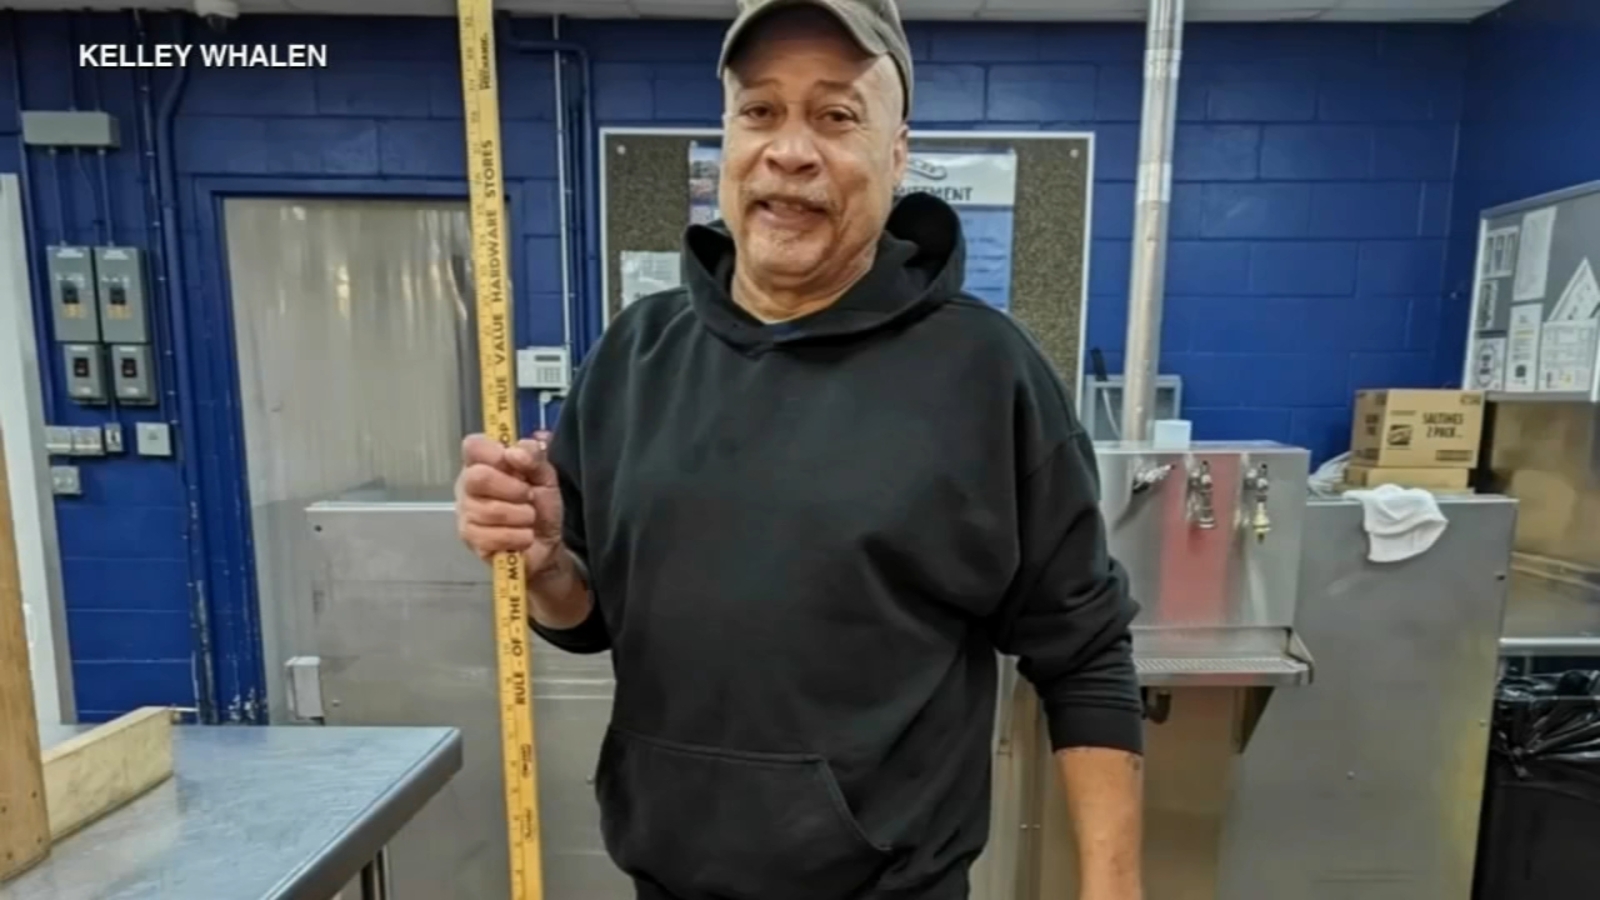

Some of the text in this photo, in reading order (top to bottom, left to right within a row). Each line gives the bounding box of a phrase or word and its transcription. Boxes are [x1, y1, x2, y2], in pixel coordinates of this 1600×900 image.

[482, 139, 497, 198] STORES
[487, 210, 503, 303] HARDWARE
[493, 314, 506, 366] VALUE
[495, 375, 508, 413] TRUE
[509, 596, 521, 621] THE
[511, 637, 523, 657] OF
[514, 671, 526, 706] RULE
